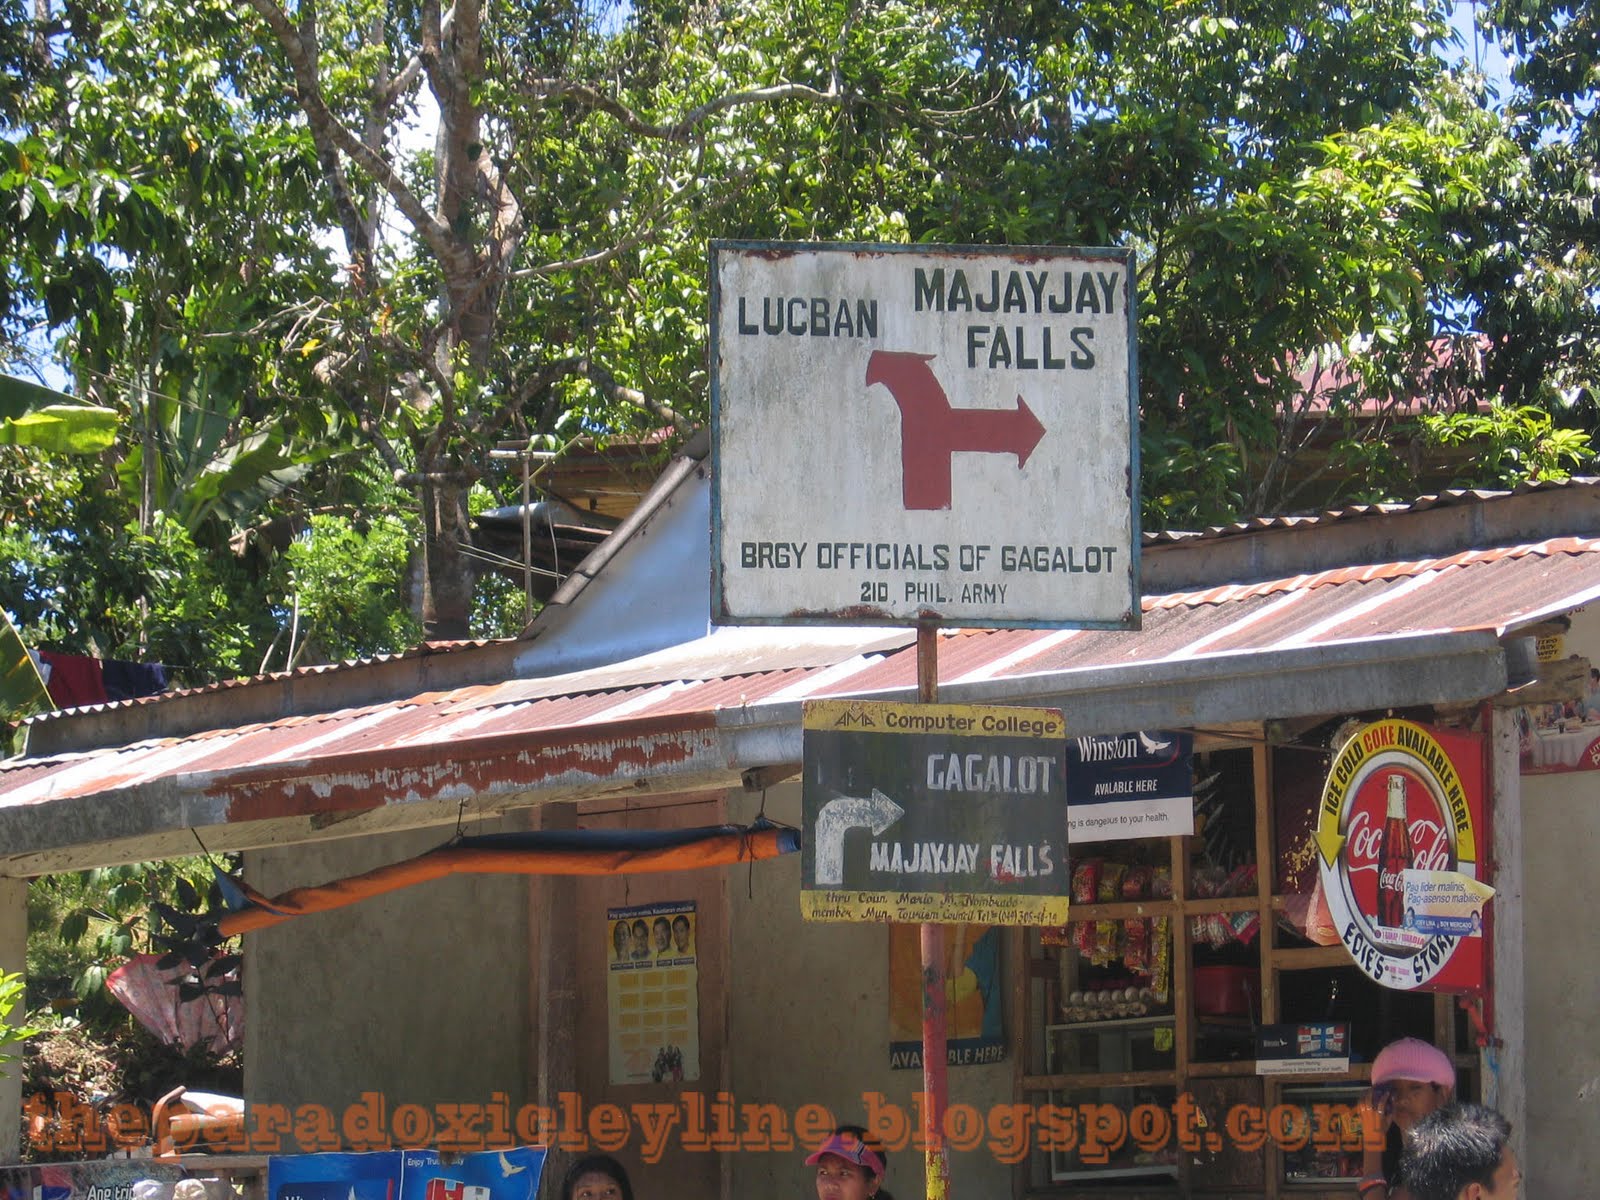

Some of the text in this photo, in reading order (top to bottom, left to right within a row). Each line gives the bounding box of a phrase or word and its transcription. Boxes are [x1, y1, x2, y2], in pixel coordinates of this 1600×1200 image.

[914, 268, 1119, 314] MAJAYJAY
[738, 297, 878, 338] LUCBAN
[967, 325, 1096, 371] FALLS
[740, 542, 1118, 573] BRGY OFFICIALS OF GAGALOT
[904, 582, 953, 603] PHIL.
[960, 583, 1008, 605] ARMY
[834, 711, 1058, 738] AMA Computer College
[1077, 736, 1138, 762] Winston
[926, 753, 1057, 794] GAGALOT
[1135, 779, 1158, 792] HERE
[1324, 725, 1470, 834] ICE COLD COKE AVAILABLE HERE
[1120, 815, 1128, 824] to
[1128, 814, 1145, 826] your
[1347, 811, 1383, 860] Coc
[869, 841, 1054, 878] MAJAYJAY FALLS
[825, 891, 851, 903] thru
[895, 892, 933, 905] Mario
[1406, 881, 1419, 895] Pag
[1420, 881, 1437, 892] lider
[811, 906, 852, 918] member
[890, 1048, 972, 1068] AVABLE
[407, 1157, 425, 1168] Enjoy
[86, 1184, 112, 1200] Ang
